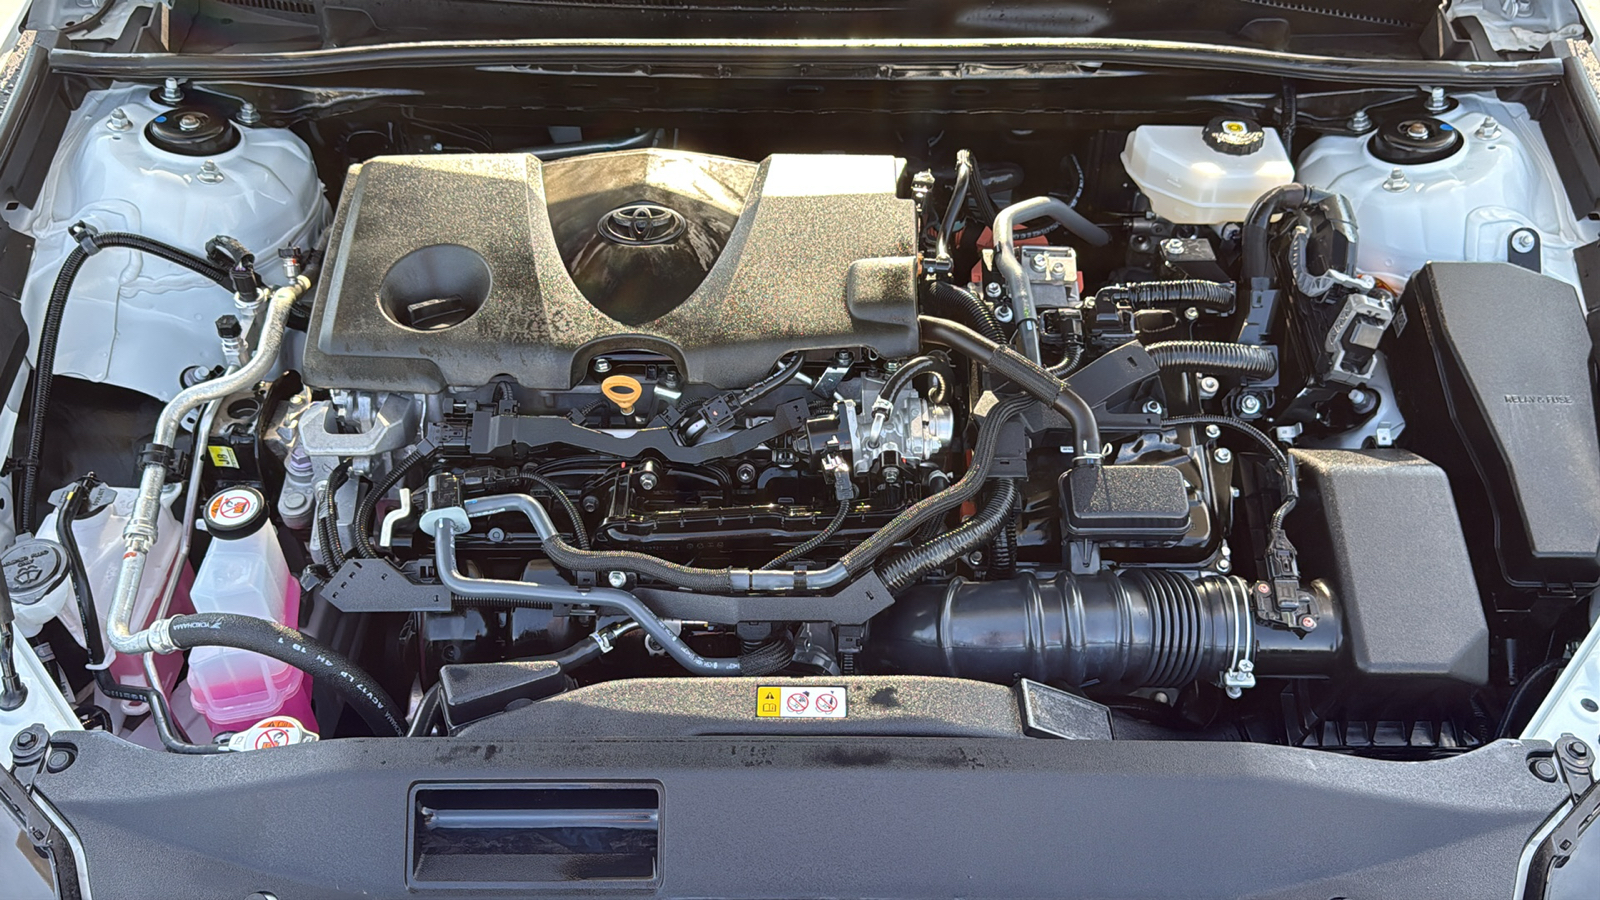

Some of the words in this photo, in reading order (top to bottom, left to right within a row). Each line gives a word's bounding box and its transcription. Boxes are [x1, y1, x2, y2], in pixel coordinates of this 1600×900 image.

[1546, 395, 1573, 404] FUSE
[172, 621, 210, 630] YOKOHAMA
[340, 671, 355, 682] LP
[356, 684, 384, 709] ACV17
[385, 710, 404, 737] OKOHAMA
